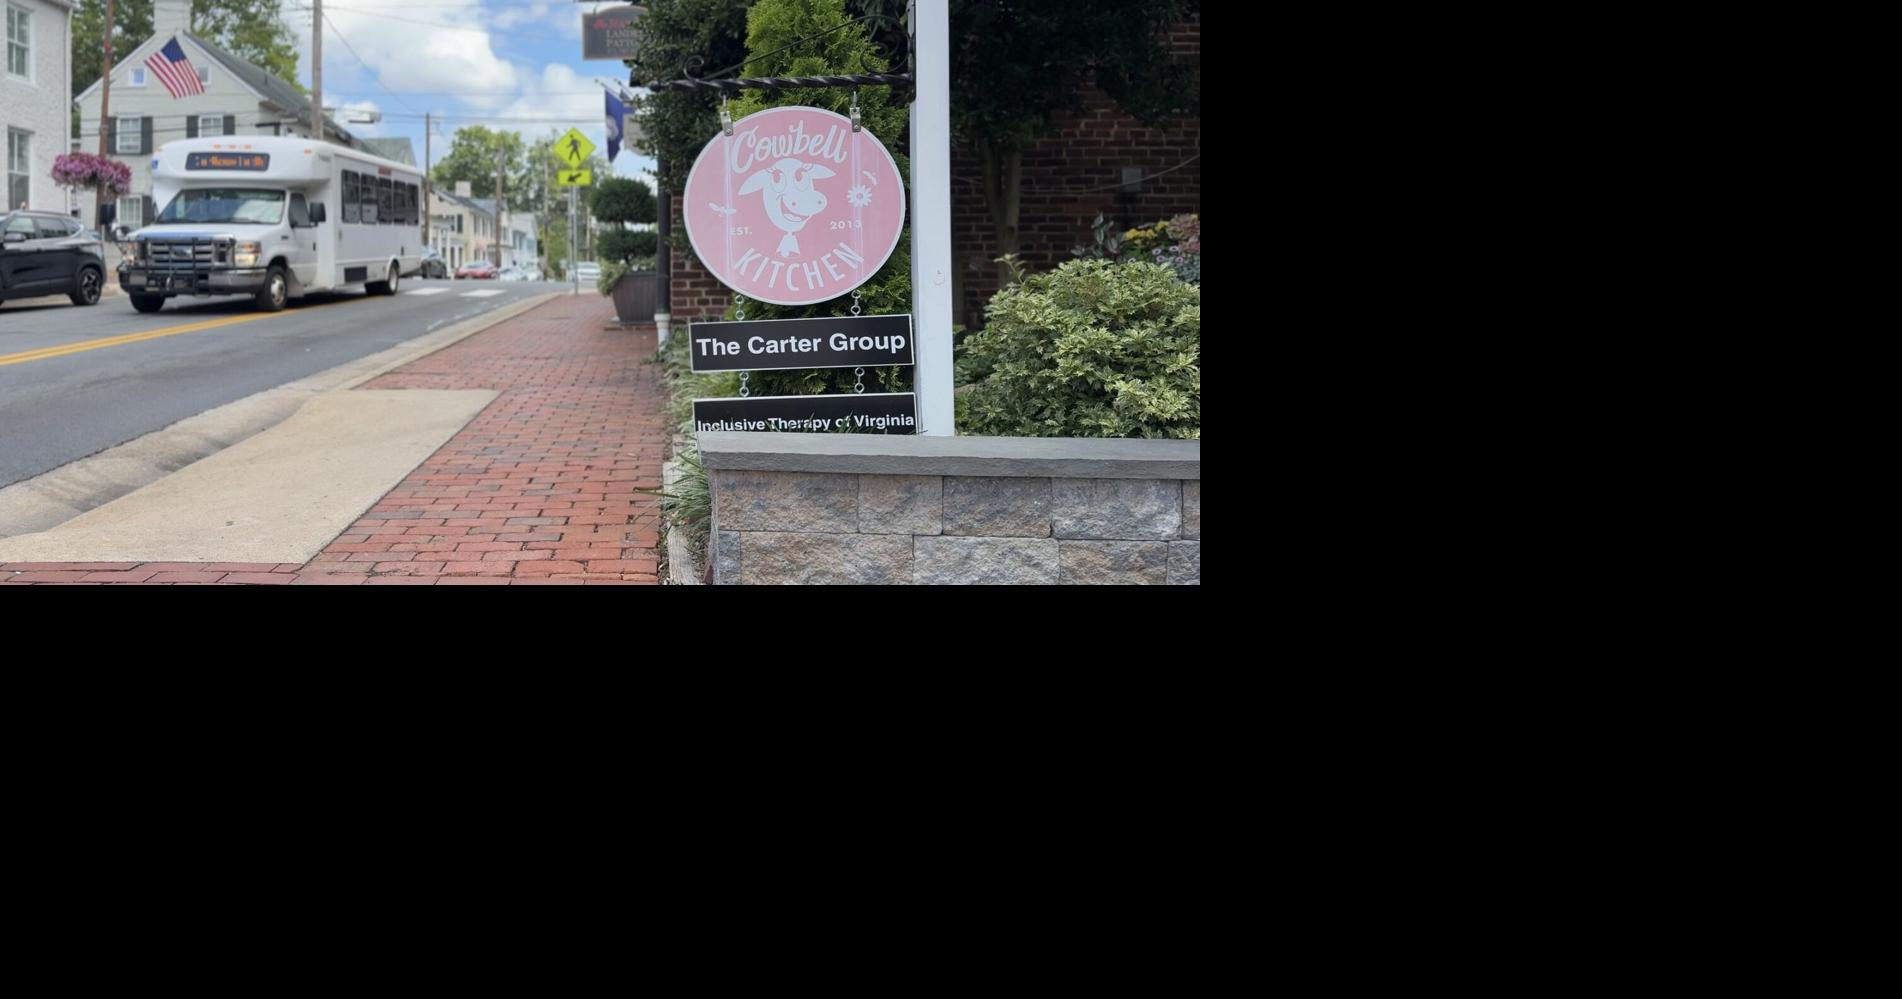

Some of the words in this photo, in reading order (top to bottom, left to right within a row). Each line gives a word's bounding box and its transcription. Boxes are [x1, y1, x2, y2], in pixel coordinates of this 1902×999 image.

[731, 120, 848, 174] Cowbell
[730, 226, 753, 236] EST.
[733, 242, 865, 292] KITCHEN
[696, 338, 741, 356] The
[747, 335, 822, 355] Carter
[829, 332, 906, 354] Group
[697, 418, 766, 432] Inclusive
[767, 416, 831, 431] Therapy
[854, 414, 915, 430] Virginia
